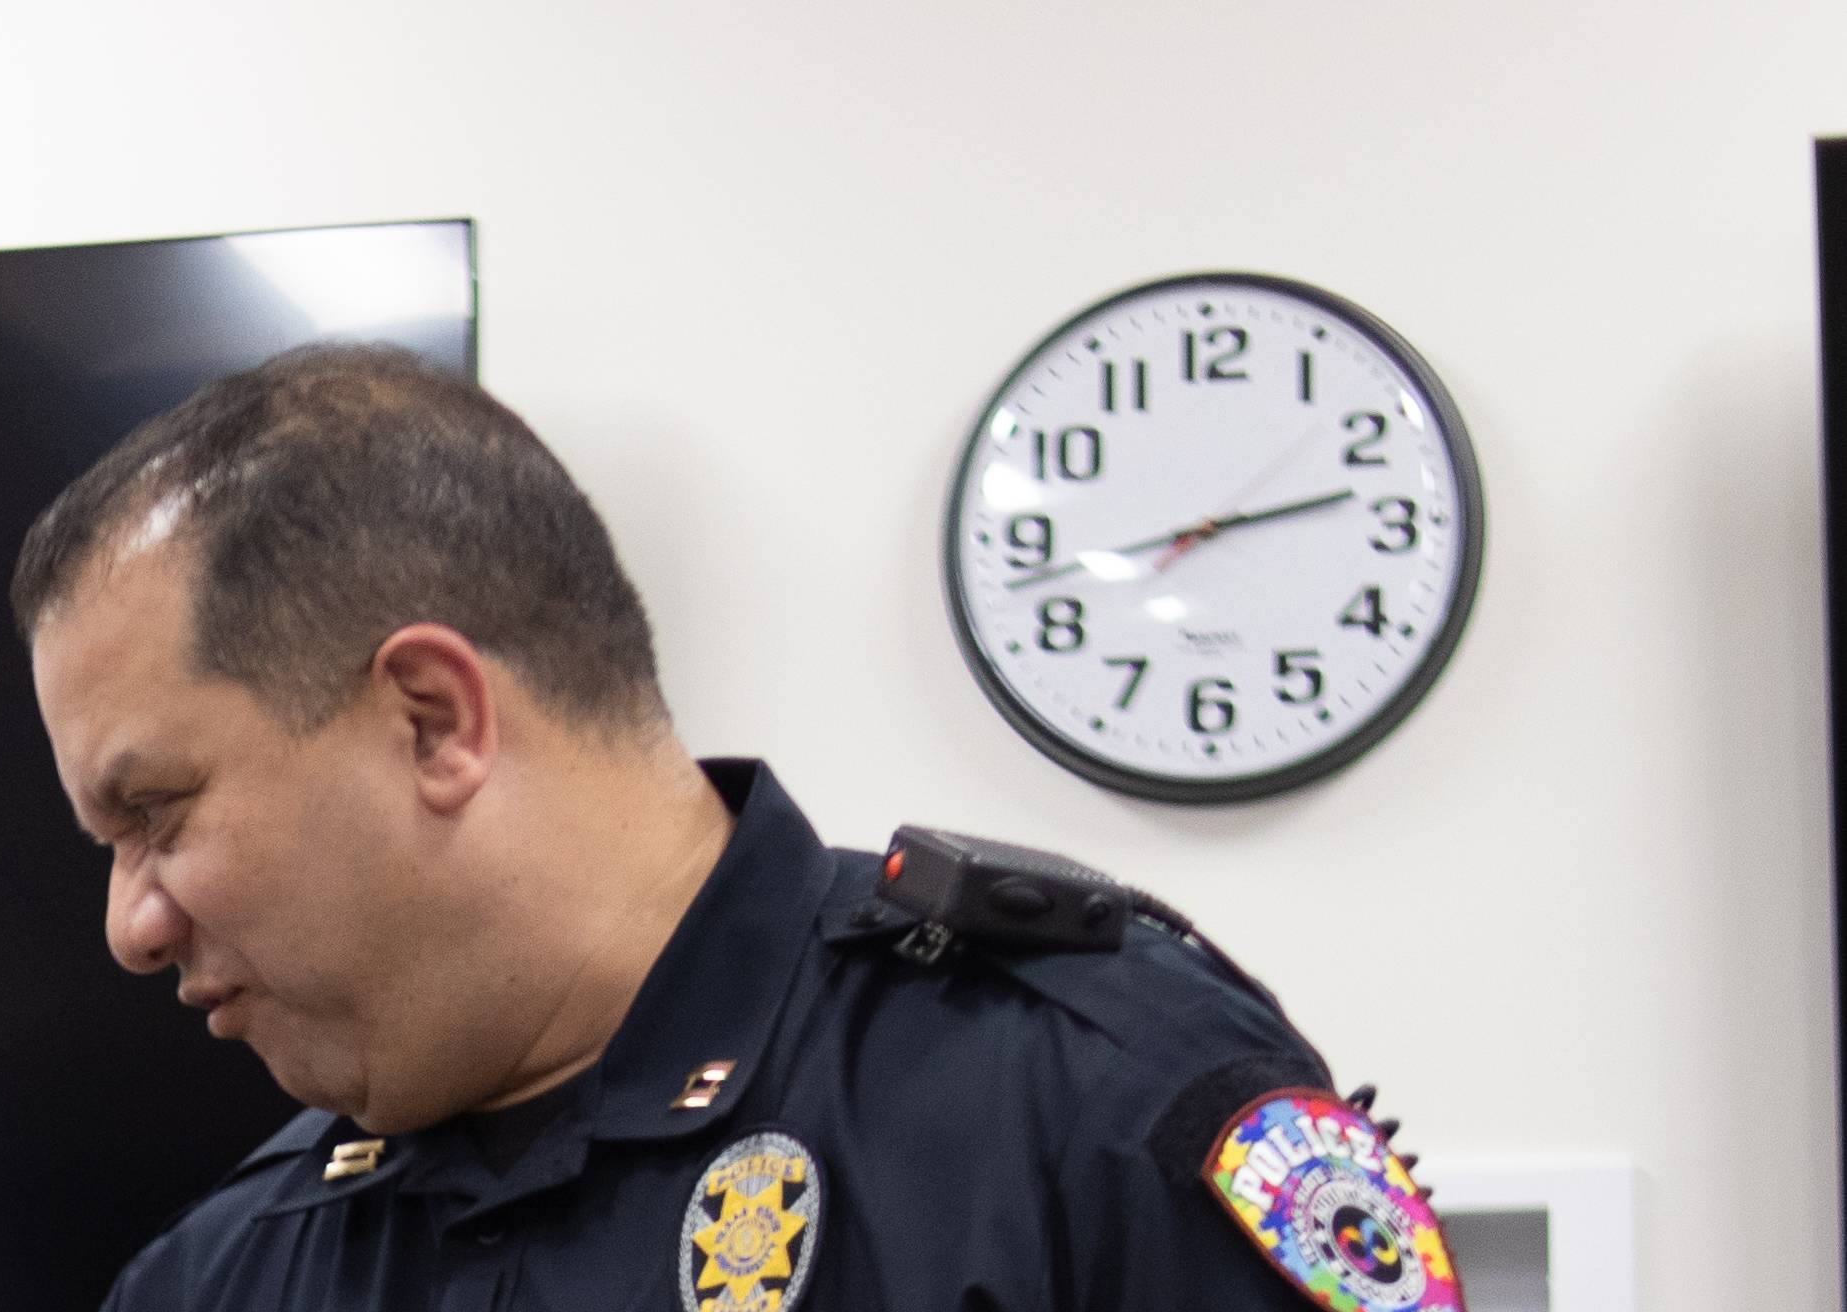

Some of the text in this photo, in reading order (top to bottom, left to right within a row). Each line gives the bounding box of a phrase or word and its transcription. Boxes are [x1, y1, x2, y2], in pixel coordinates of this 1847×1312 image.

[1179, 323, 1249, 384] 12
[1296, 348, 1314, 404] 1
[1099, 357, 1149, 414] 11
[1031, 422, 1103, 482] 10
[1340, 410, 1388, 468] 2
[1004, 512, 1053, 570] 9
[1367, 496, 1419, 555] 3
[1034, 595, 1086, 654] 8
[1335, 583, 1392, 639] 4
[1103, 655, 1149, 711] 7
[1272, 647, 1325, 704] 5
[1185, 675, 1236, 735] 6
[1231, 1114, 1384, 1211] POLICE
